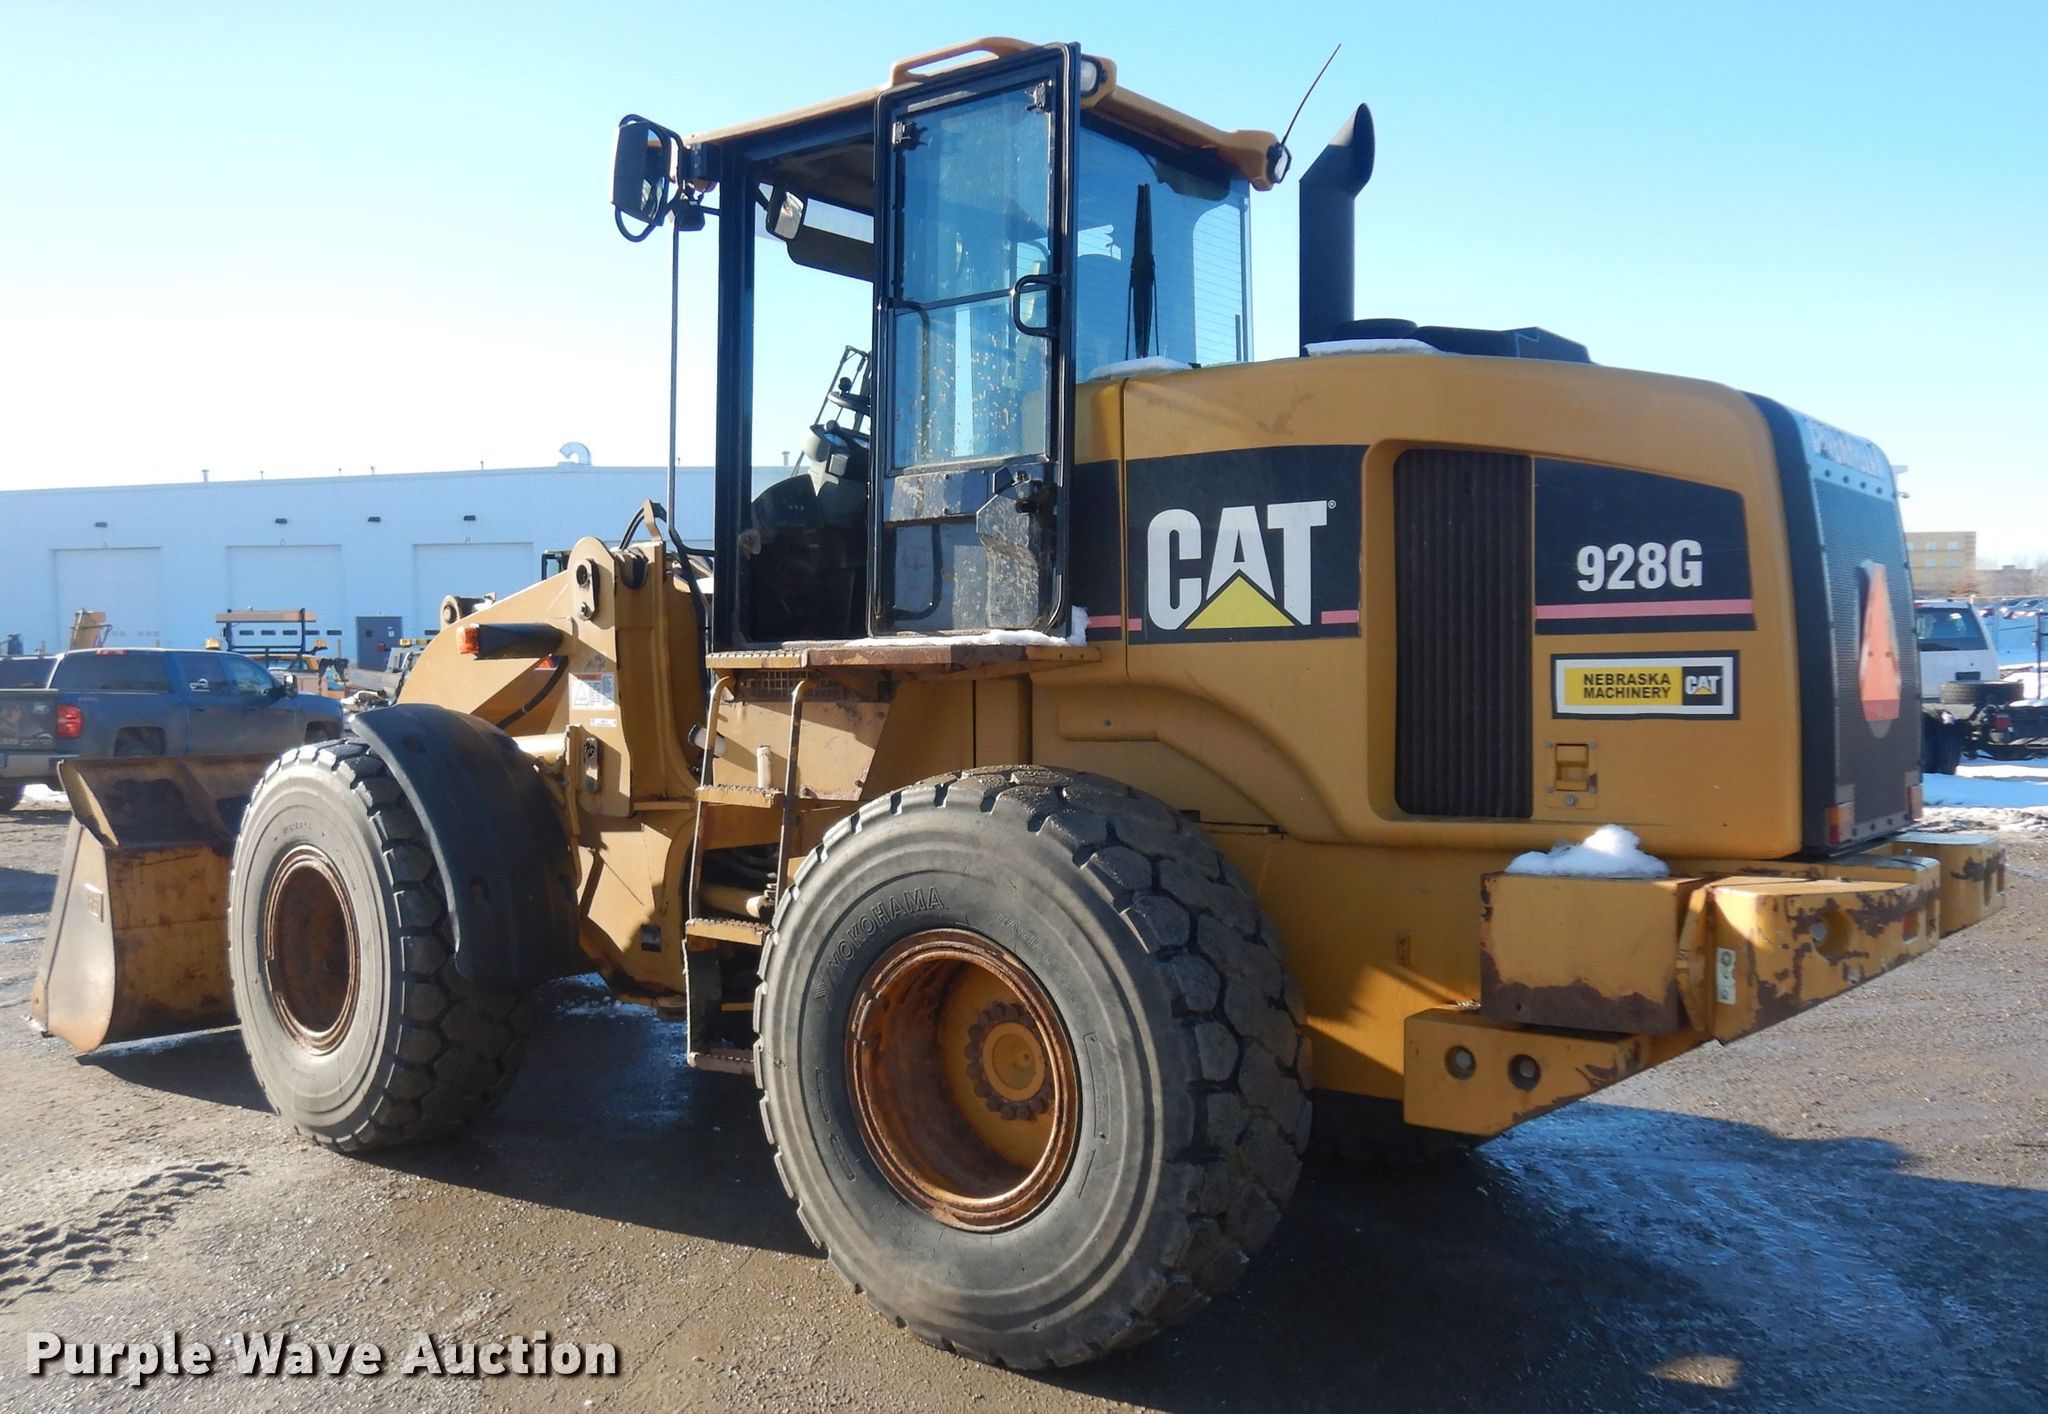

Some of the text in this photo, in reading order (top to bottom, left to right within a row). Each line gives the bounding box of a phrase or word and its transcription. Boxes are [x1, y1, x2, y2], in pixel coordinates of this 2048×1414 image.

[1148, 501, 1327, 630] CAT
[1577, 540, 1703, 592] 928G
[1583, 673, 1672, 686] NEBRASKA
[1583, 686, 1672, 699] MACHINERY
[1684, 675, 1721, 695] CAT
[828, 886, 944, 970] YOKOHAMA
